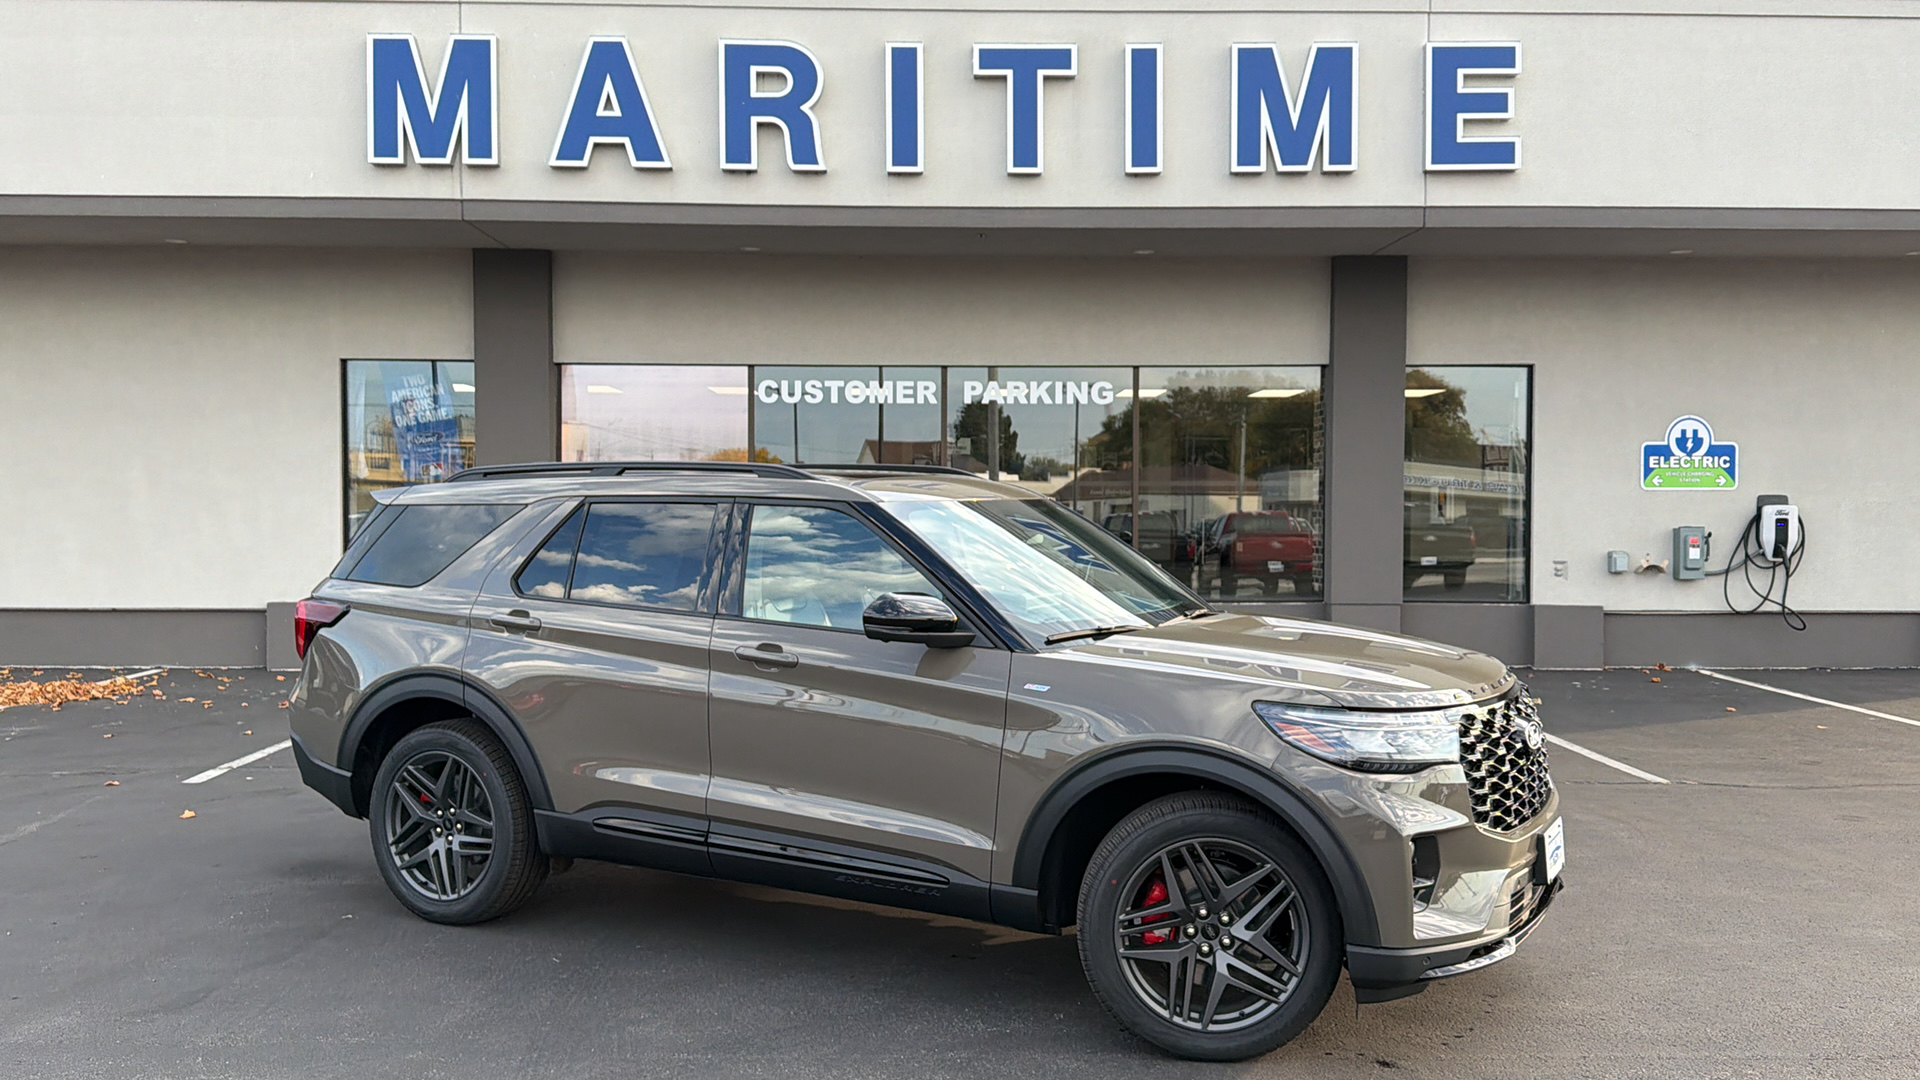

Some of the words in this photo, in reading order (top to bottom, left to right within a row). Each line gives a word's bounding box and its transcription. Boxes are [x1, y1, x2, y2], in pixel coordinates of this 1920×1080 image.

[367, 33, 1523, 175] MARITIME
[402, 374, 425, 387] TWO
[391, 383, 444, 403] AMERICAN
[757, 379, 938, 404] CUSTOMER
[963, 381, 1115, 405] PARKING
[395, 413, 417, 428] ONE
[1649, 456, 1731, 468] ELECTRIC
